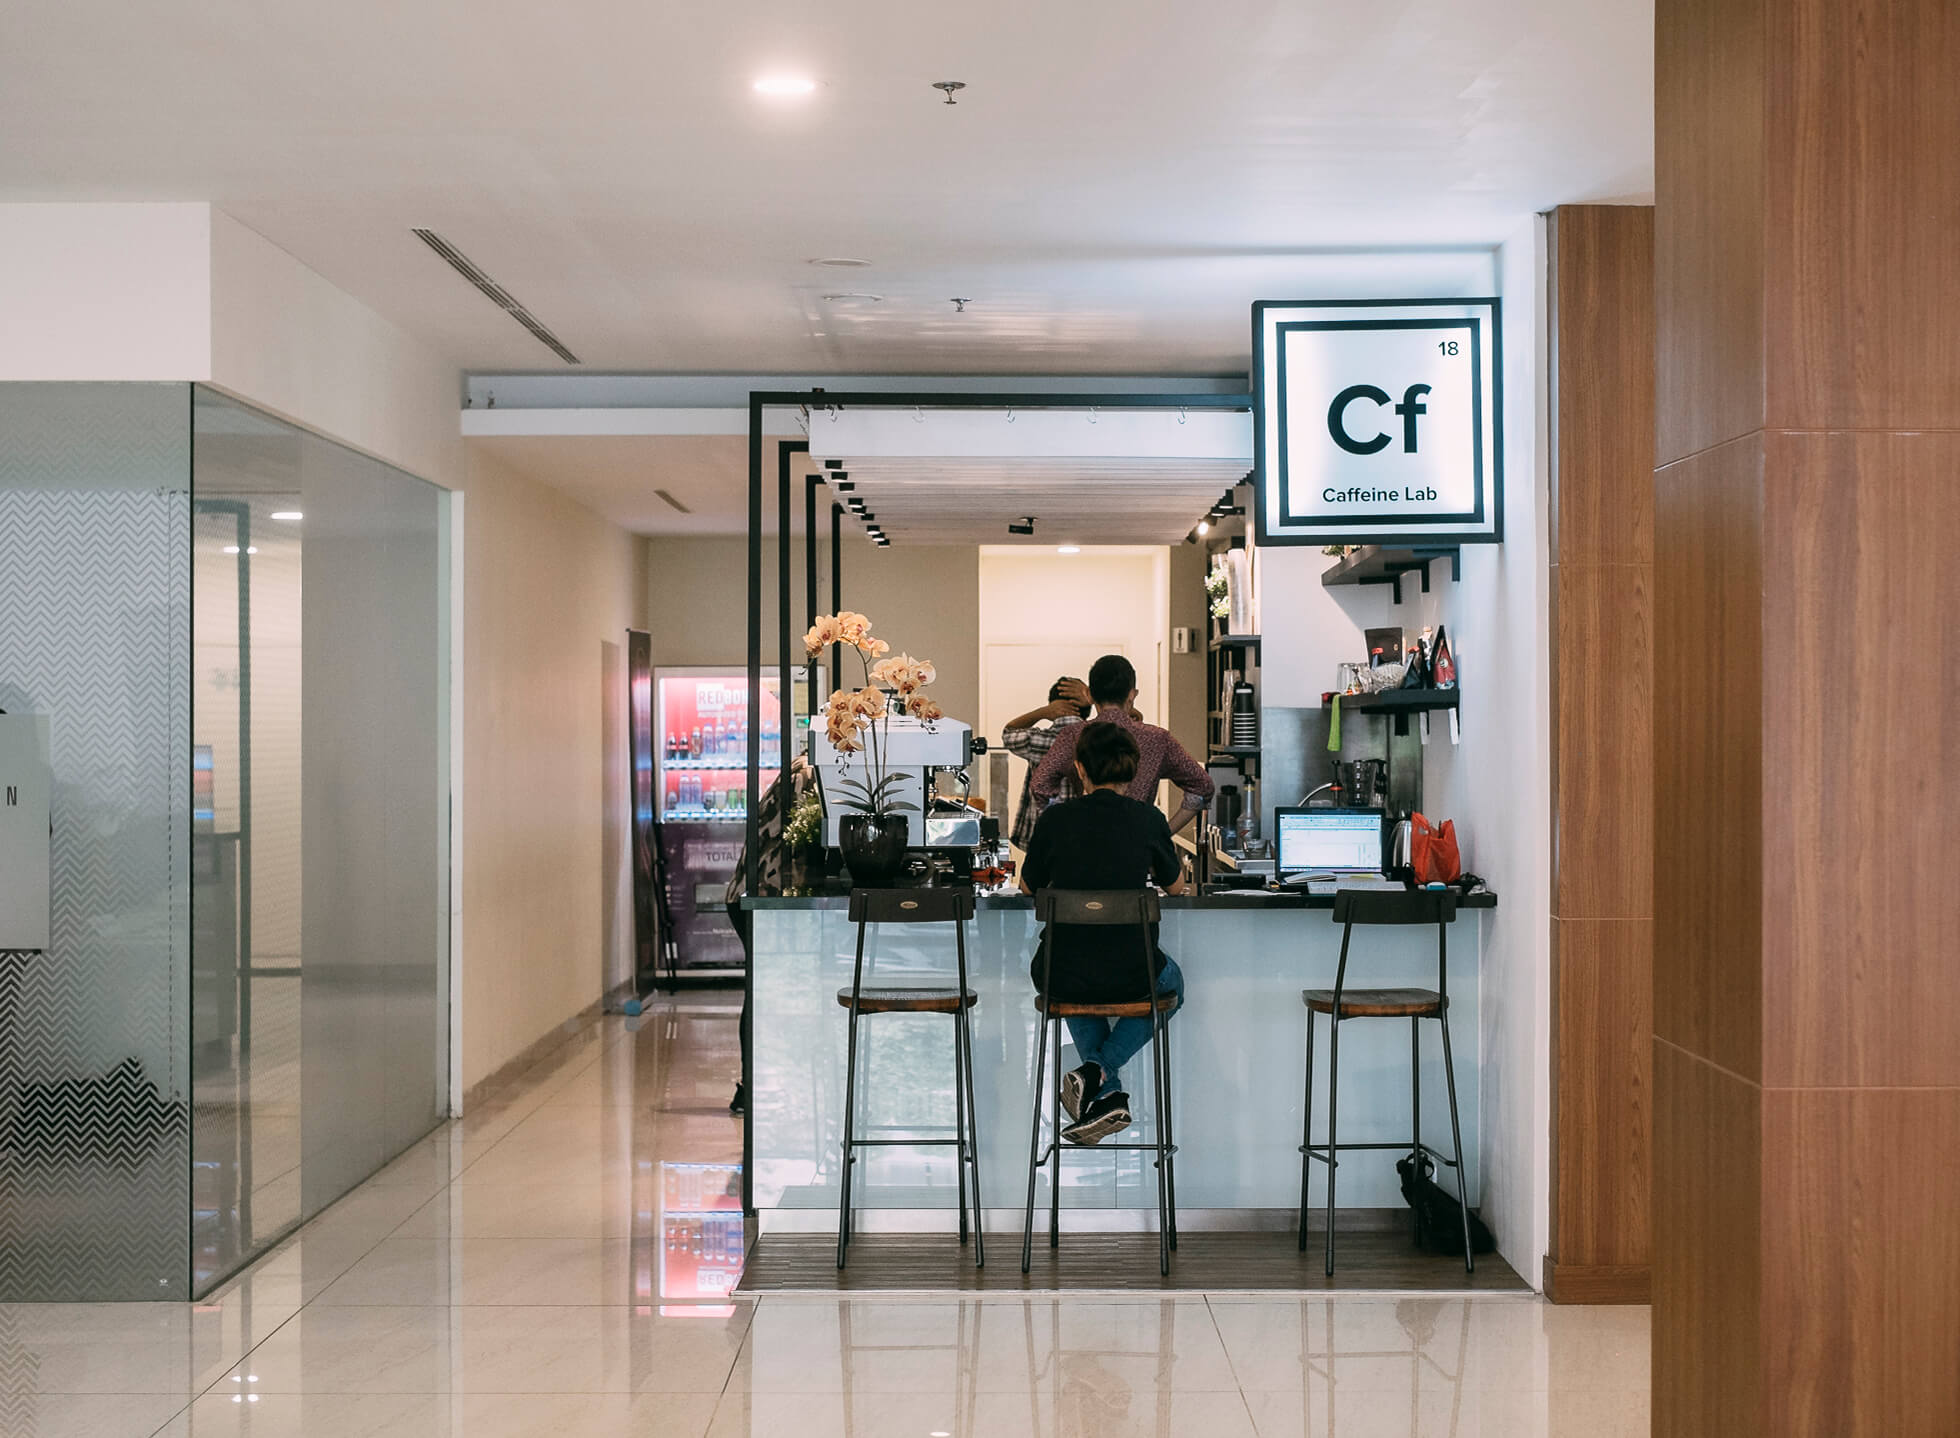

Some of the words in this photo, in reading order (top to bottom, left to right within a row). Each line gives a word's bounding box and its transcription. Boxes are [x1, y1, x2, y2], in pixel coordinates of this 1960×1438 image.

[1438, 341, 1459, 356] 18
[1327, 383, 1432, 456] Cf
[1322, 487, 1399, 503] Caffeine
[1405, 486, 1437, 501] Lab
[7, 786, 17, 806] N
